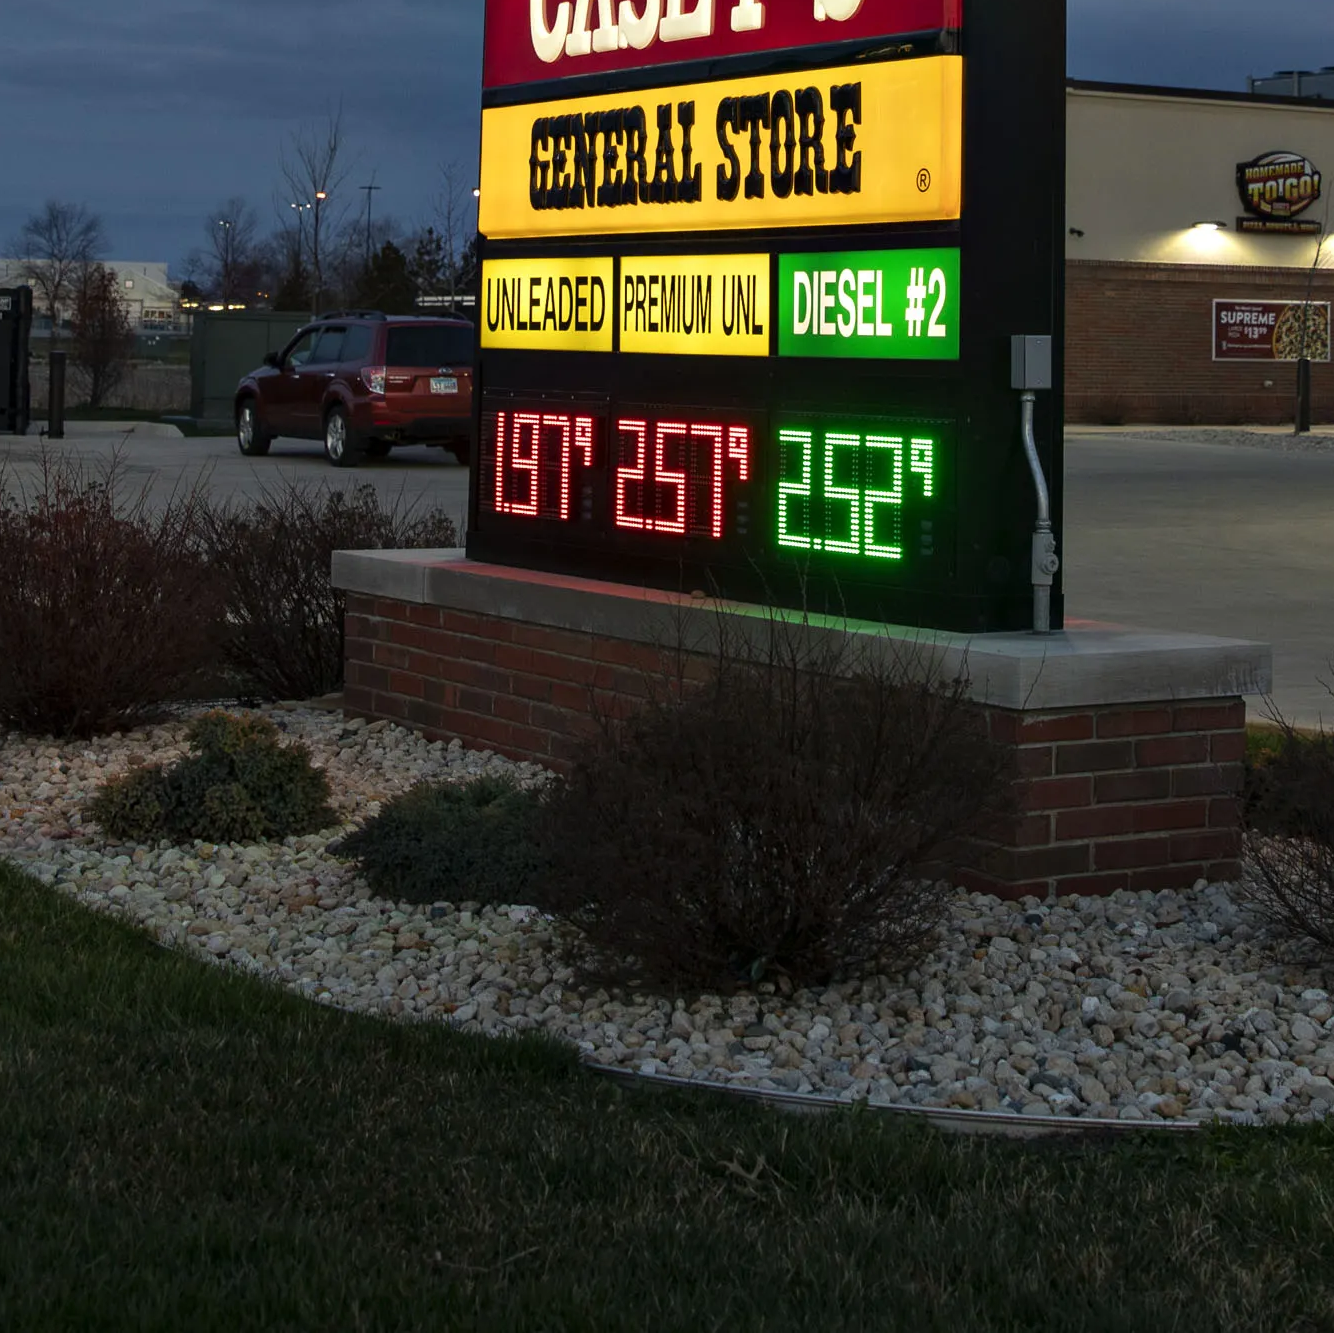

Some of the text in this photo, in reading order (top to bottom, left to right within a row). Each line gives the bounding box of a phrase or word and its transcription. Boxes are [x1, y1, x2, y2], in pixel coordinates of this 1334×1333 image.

[528, 100, 702, 211] GENERAL
[715, 81, 862, 202] STORE
[1245, 162, 1304, 179] HOMEMADE
[486, 276, 606, 332] UNLEADED
[624, 274, 763, 336] PREMIUM UNL
[793, 266, 947, 338] DIESEL #2
[1220, 311, 1276, 326] SUPREME
